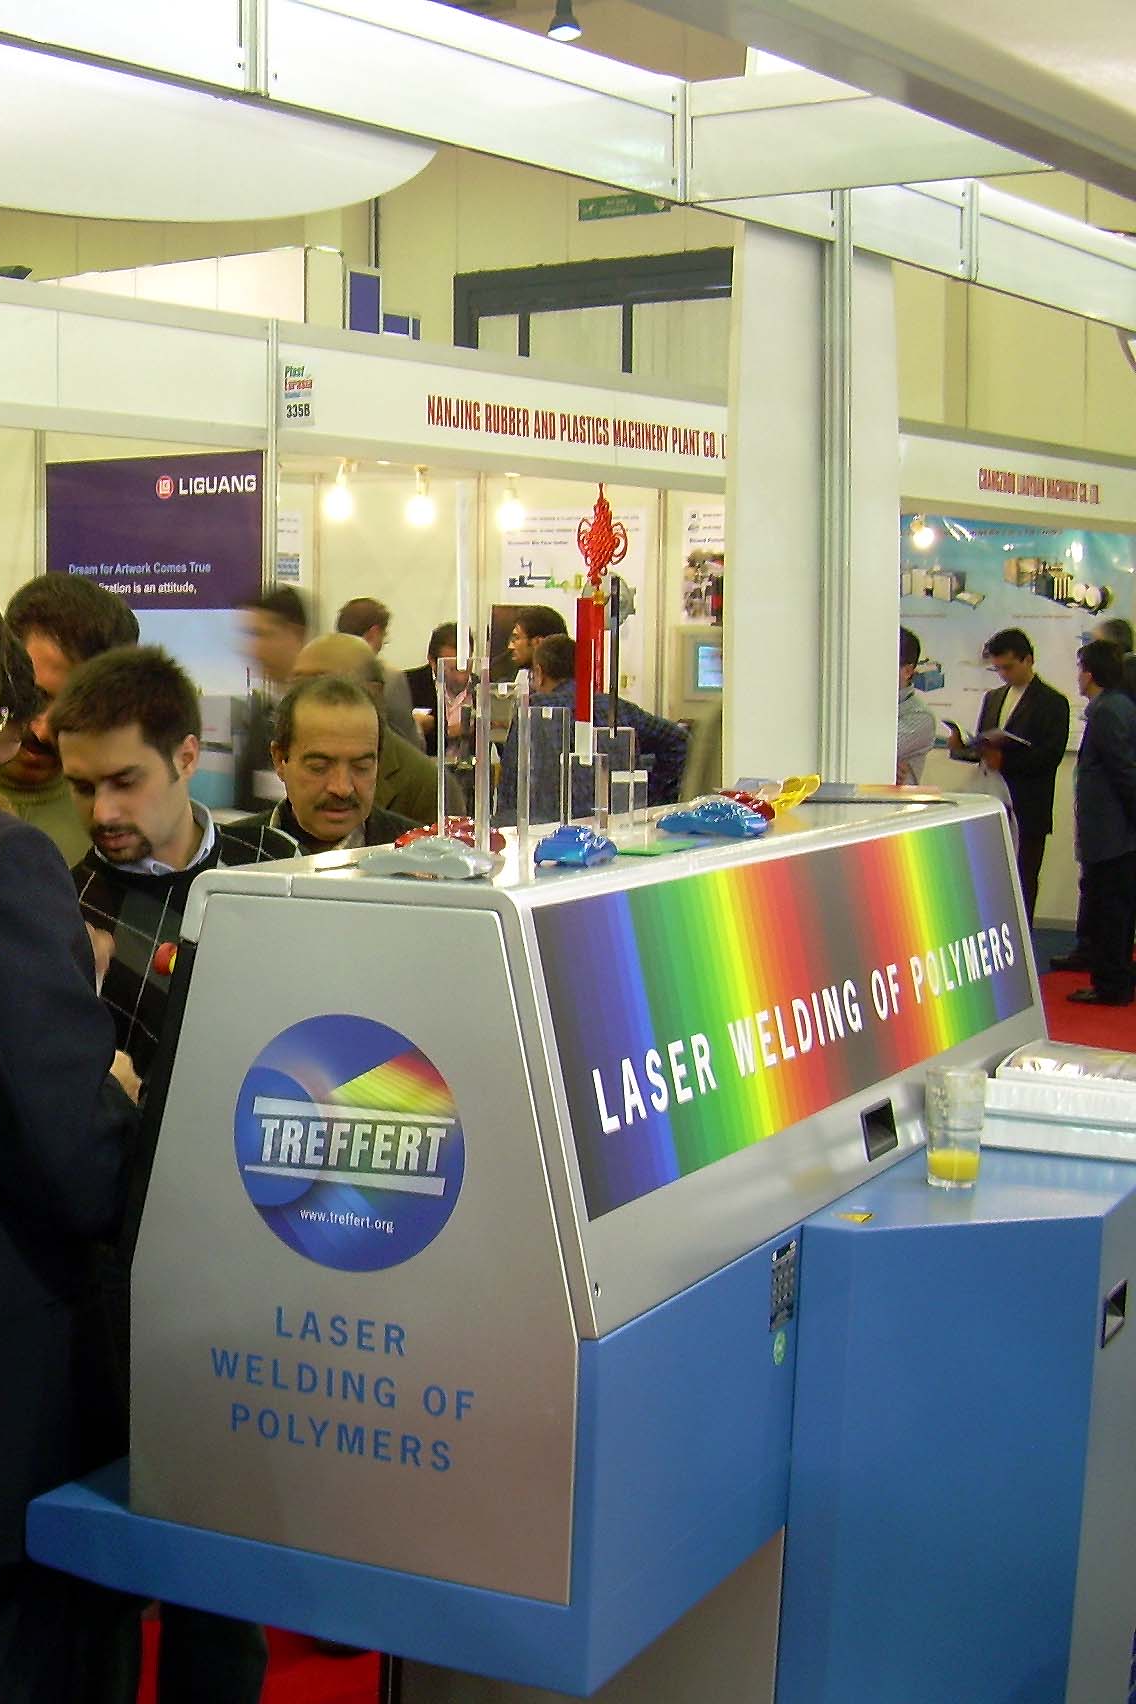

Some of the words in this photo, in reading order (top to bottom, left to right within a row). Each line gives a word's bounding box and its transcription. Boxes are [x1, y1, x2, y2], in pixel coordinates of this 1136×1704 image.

[286, 403, 311, 418] 335B
[427, 394, 481, 431] NANJING
[485, 403, 530, 437] RUBBER
[534, 410, 556, 440] AND
[560, 413, 610, 446] PLASTICS
[613, 418, 669, 453] MACHINERY
[672, 427, 700, 456] PLANT
[179, 474, 257, 496] LIGUANG
[69, 563, 98, 576] Dream
[100, 563, 113, 576] for
[115, 562, 151, 576] Artwork
[154, 562, 187, 574] Comes
[190, 561, 211, 573] True
[134, 582, 141, 594] is
[144, 584, 155, 594] an
[158, 581, 197, 595] attitude,
[592, 1033, 718, 1135] LASER
[727, 979, 863, 1078] WELDING
[871, 963, 900, 1021] OF
[909, 922, 1015, 1004] POLYMERS
[261, 1119, 446, 1172] TREFFERT
[299, 1209, 394, 1233] www.treffert.org
[275, 1306, 406, 1357] LASER
[211, 1347, 396, 1409] WELDING
[423, 1384, 475, 1421] OF
[231, 1402, 452, 1472] POLYMERS
